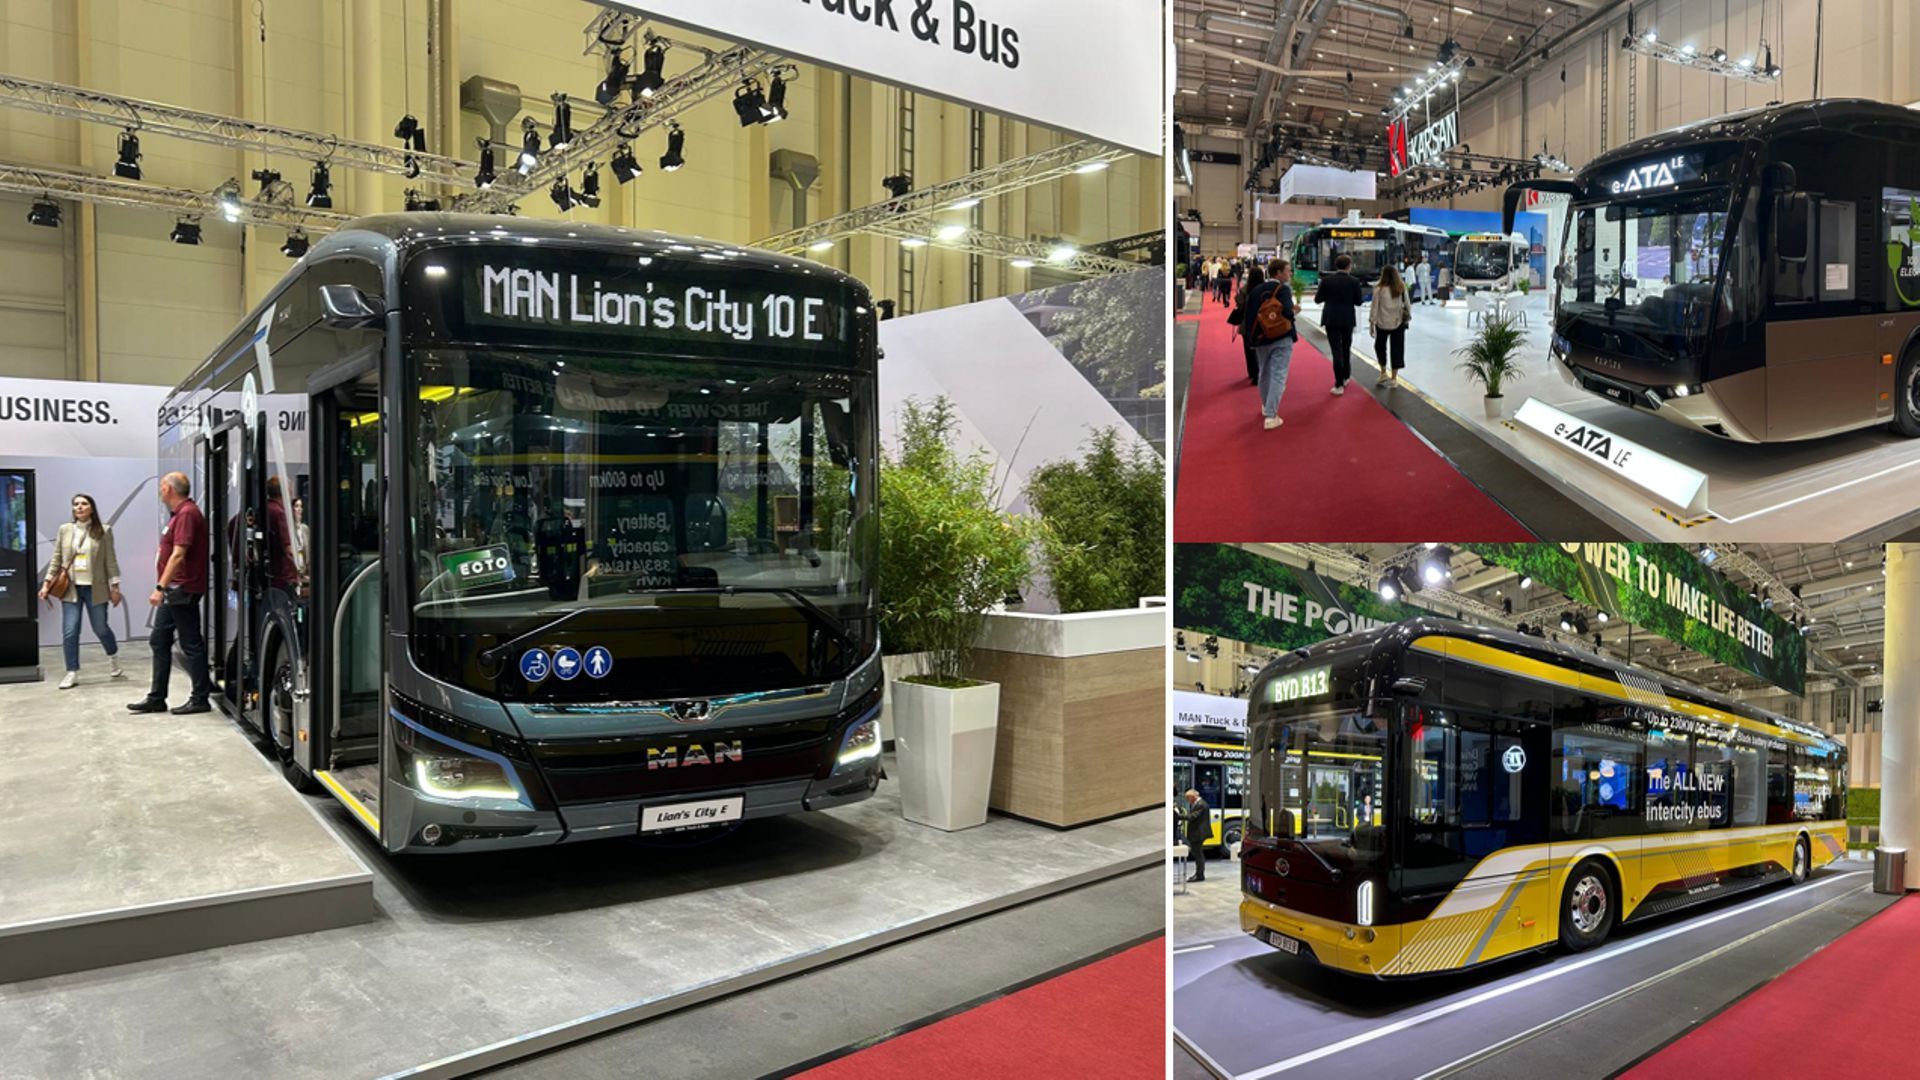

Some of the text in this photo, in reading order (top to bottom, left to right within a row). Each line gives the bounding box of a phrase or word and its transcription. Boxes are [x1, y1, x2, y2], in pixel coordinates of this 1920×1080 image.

[953, 0, 1019, 69] Bus
[1411, 111, 1457, 165] KARSAN
[1671, 155, 1685, 169] LE
[483, 264, 824, 340] MAN Lion's City 10 E
[1554, 422, 1632, 468] e-ATA LE
[1243, 581, 1298, 624] THE
[1635, 555, 1660, 599] TO
[1665, 571, 1708, 625] MAKE
[1711, 599, 1736, 639] LIFE
[1737, 613, 1774, 660] BETTER
[1274, 678, 1299, 703] BYD
[1178, 712, 1201, 723] MAN
[1204, 714, 1231, 726] Truck
[1232, 717, 1240, 727] &
[647, 740, 743, 770] MAN
[1198, 749, 1212, 760] Up
[1213, 750, 1223, 758] to
[1646, 768, 1723, 792] The ALL NEW
[656, 804, 729, 823] Lion's City E
[1646, 800, 1722, 825] intercity ebus
